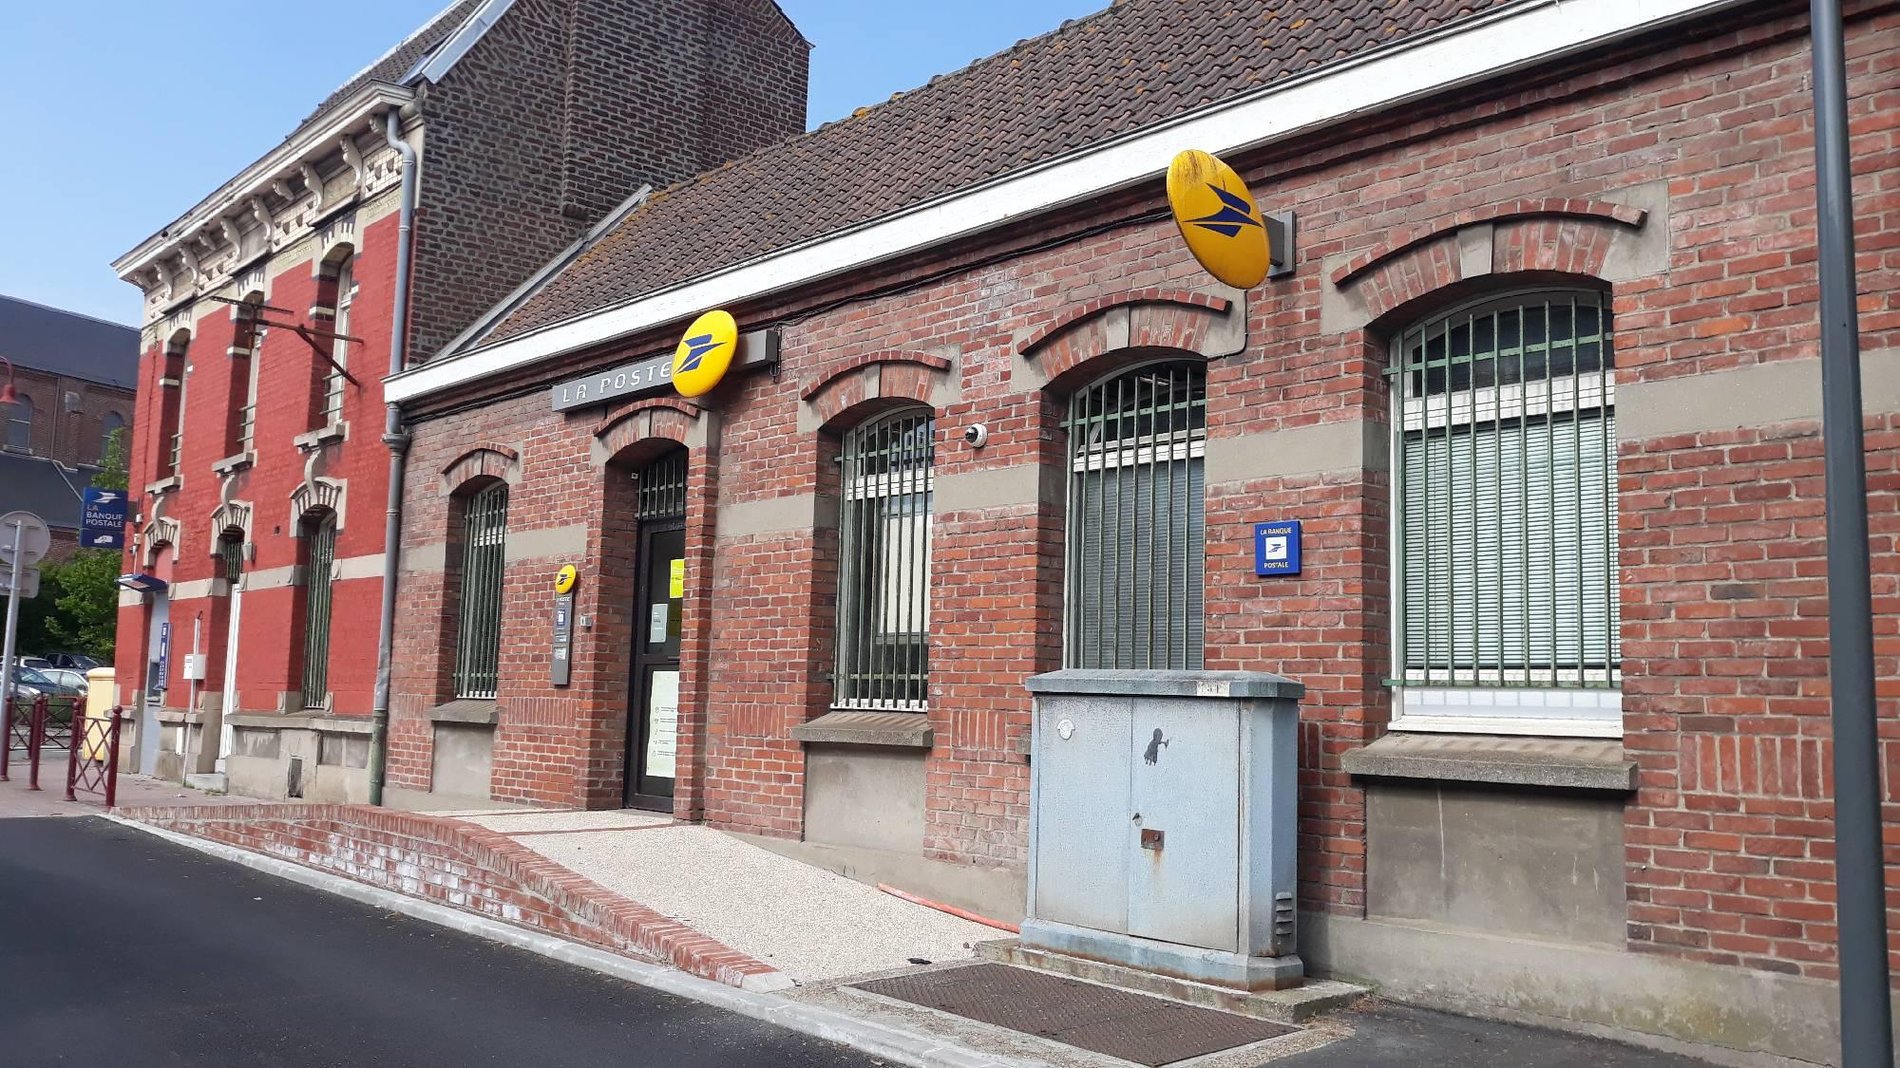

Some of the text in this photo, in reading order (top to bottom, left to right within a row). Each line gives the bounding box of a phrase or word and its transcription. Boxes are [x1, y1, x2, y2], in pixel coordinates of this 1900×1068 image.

[562, 361, 672, 402] LA POSTE
[86, 511, 123, 520] BANQUE
[85, 519, 122, 528] POSTALE
[1267, 527, 1292, 535] BANQUE
[1263, 561, 1289, 569] POSTALE
